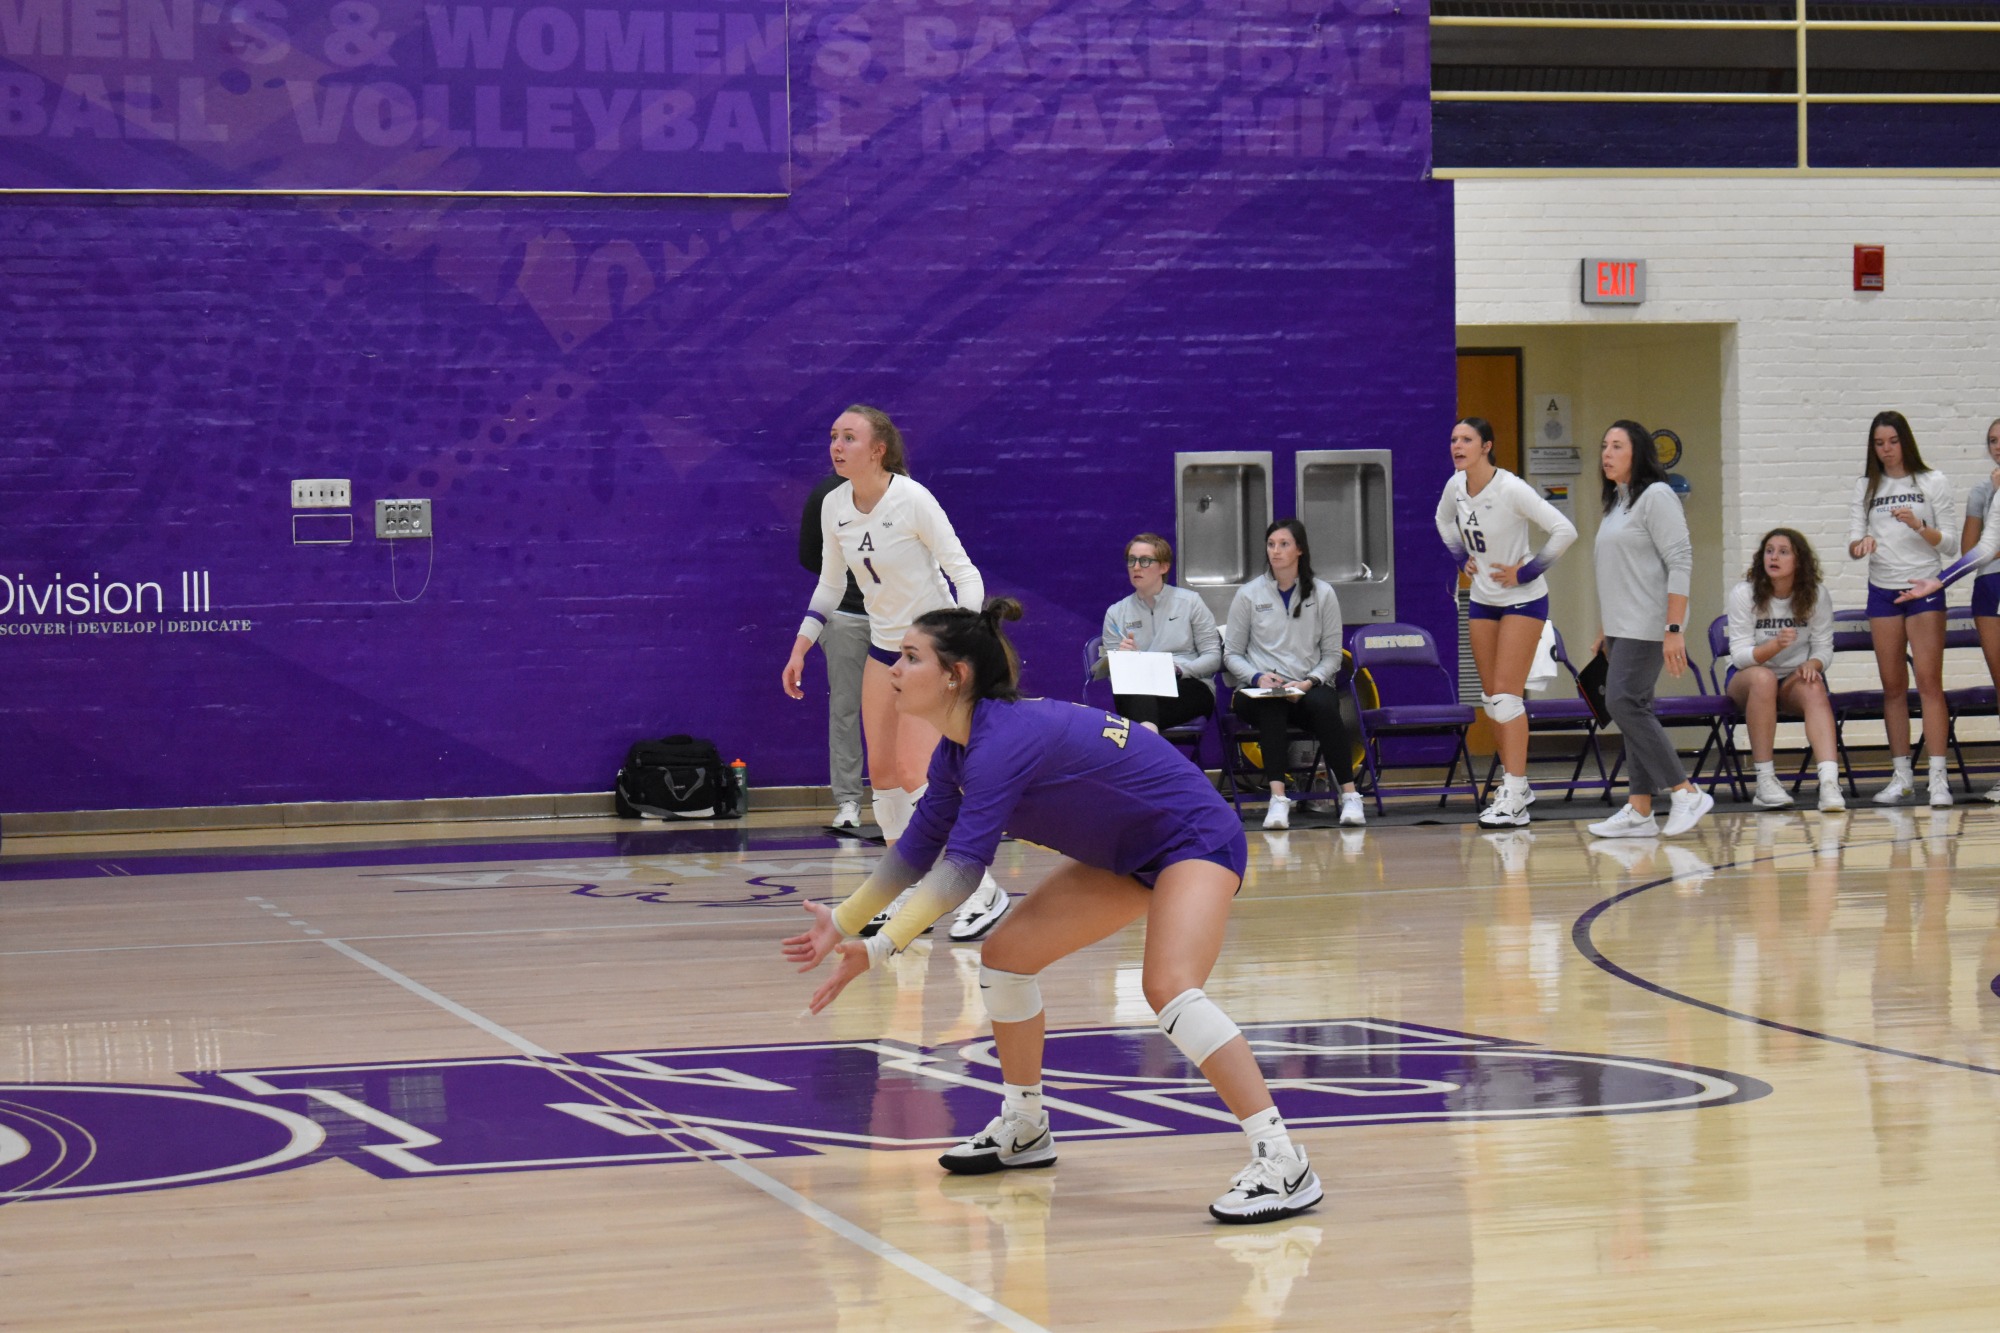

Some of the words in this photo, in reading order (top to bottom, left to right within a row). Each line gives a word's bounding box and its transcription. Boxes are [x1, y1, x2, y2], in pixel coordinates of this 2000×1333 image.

[323, 0, 397, 67] &
[285, 79, 868, 154] VOLLEYBALL
[1598, 262, 1637, 297] EXIT
[1546, 399, 1559, 411] A
[1466, 511, 1479, 526] A
[858, 531, 875, 551] A
[1464, 529, 1486, 553] 16
[863, 557, 881, 584] 1
[0, 622, 66, 636] SCOVER
[77, 620, 157, 634] DEVELOP
[167, 619, 252, 633] DEDICATE
